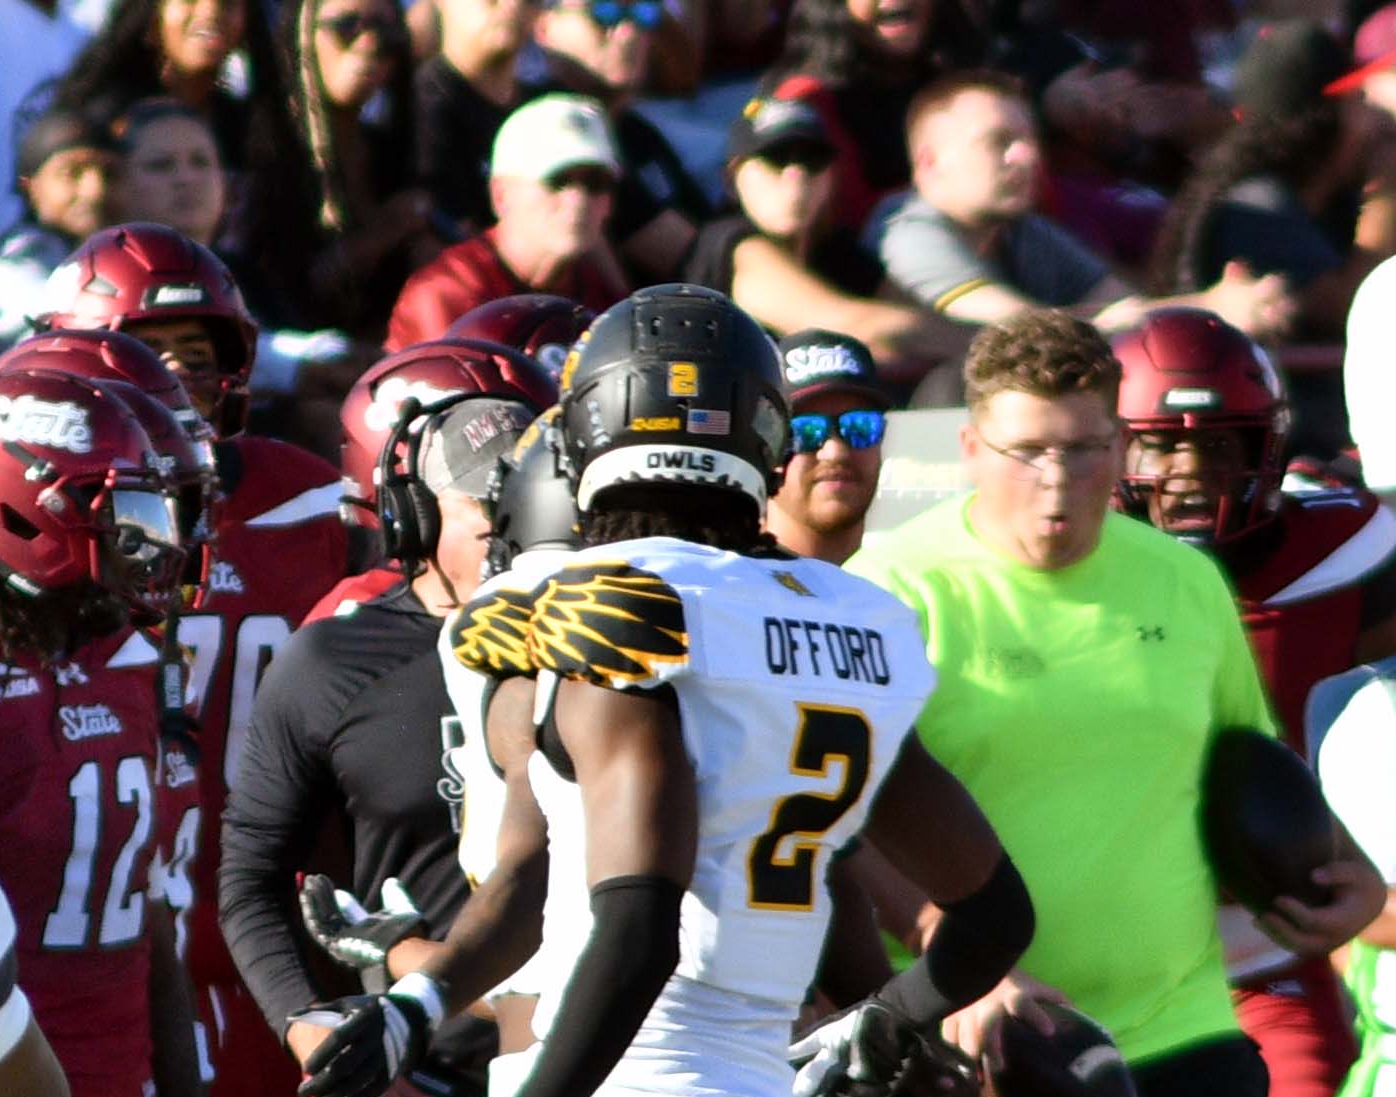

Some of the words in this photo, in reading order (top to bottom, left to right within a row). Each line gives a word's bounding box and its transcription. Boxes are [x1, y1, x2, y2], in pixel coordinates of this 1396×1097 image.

[668, 361, 698, 396] 2
[785, 344, 860, 384] State
[646, 450, 716, 474] OWLS
[763, 616, 891, 686] OFFORD
[59, 704, 122, 741] State
[746, 700, 873, 912] 2
[42, 755, 152, 947] 12
